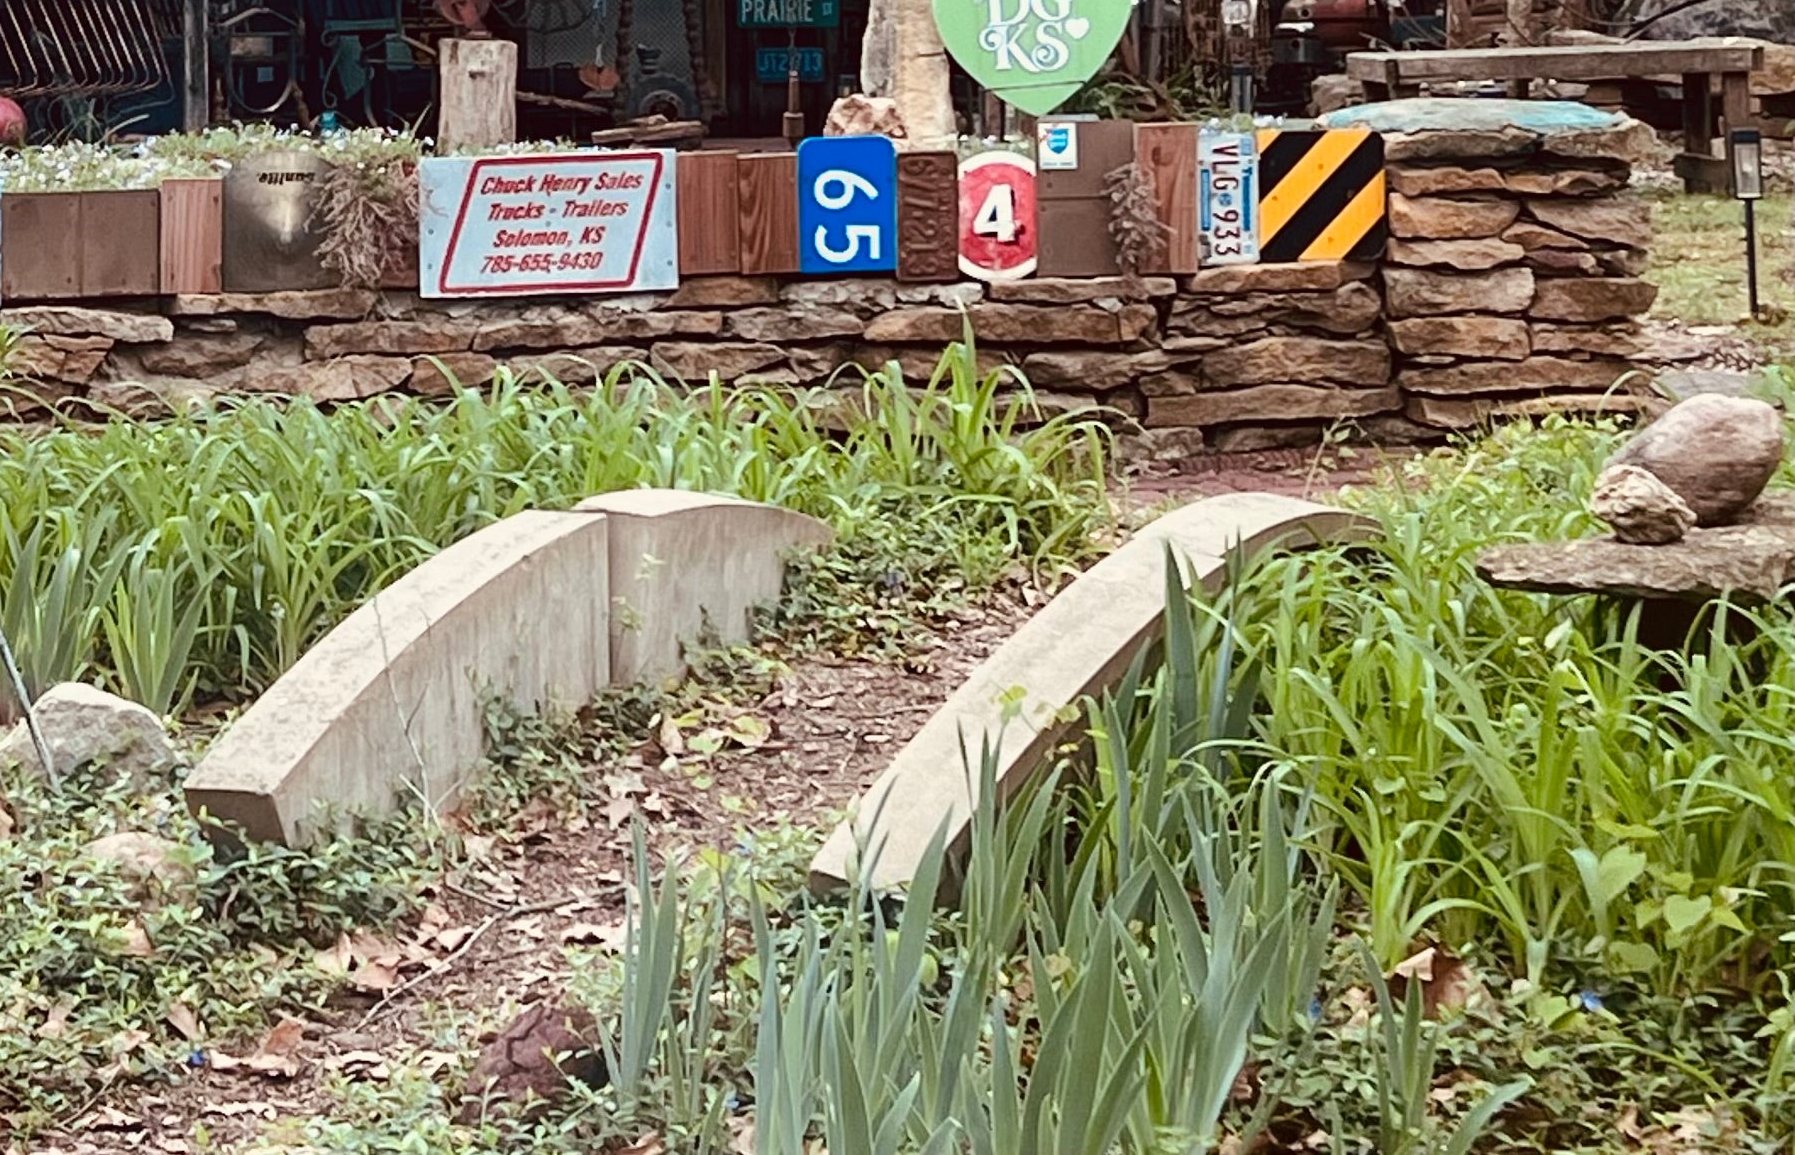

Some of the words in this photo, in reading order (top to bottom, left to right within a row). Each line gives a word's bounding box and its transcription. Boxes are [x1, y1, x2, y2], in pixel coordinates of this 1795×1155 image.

[978, 22, 1070, 74] KS
[481, 176, 537, 196] Chuck
[539, 173, 593, 196] Henry
[594, 171, 644, 191] Sales
[1211, 144, 1240, 191] VLG
[487, 201, 546, 222] Trucks
[561, 199, 630, 219] Trailers
[813, 169, 879, 264] 65
[973, 183, 1023, 243] 4
[1212, 209, 1241, 256] 933
[493, 228, 573, 249] Solomon,
[578, 226, 606, 245] KS
[479, 251, 604, 275] 785-655-9430
